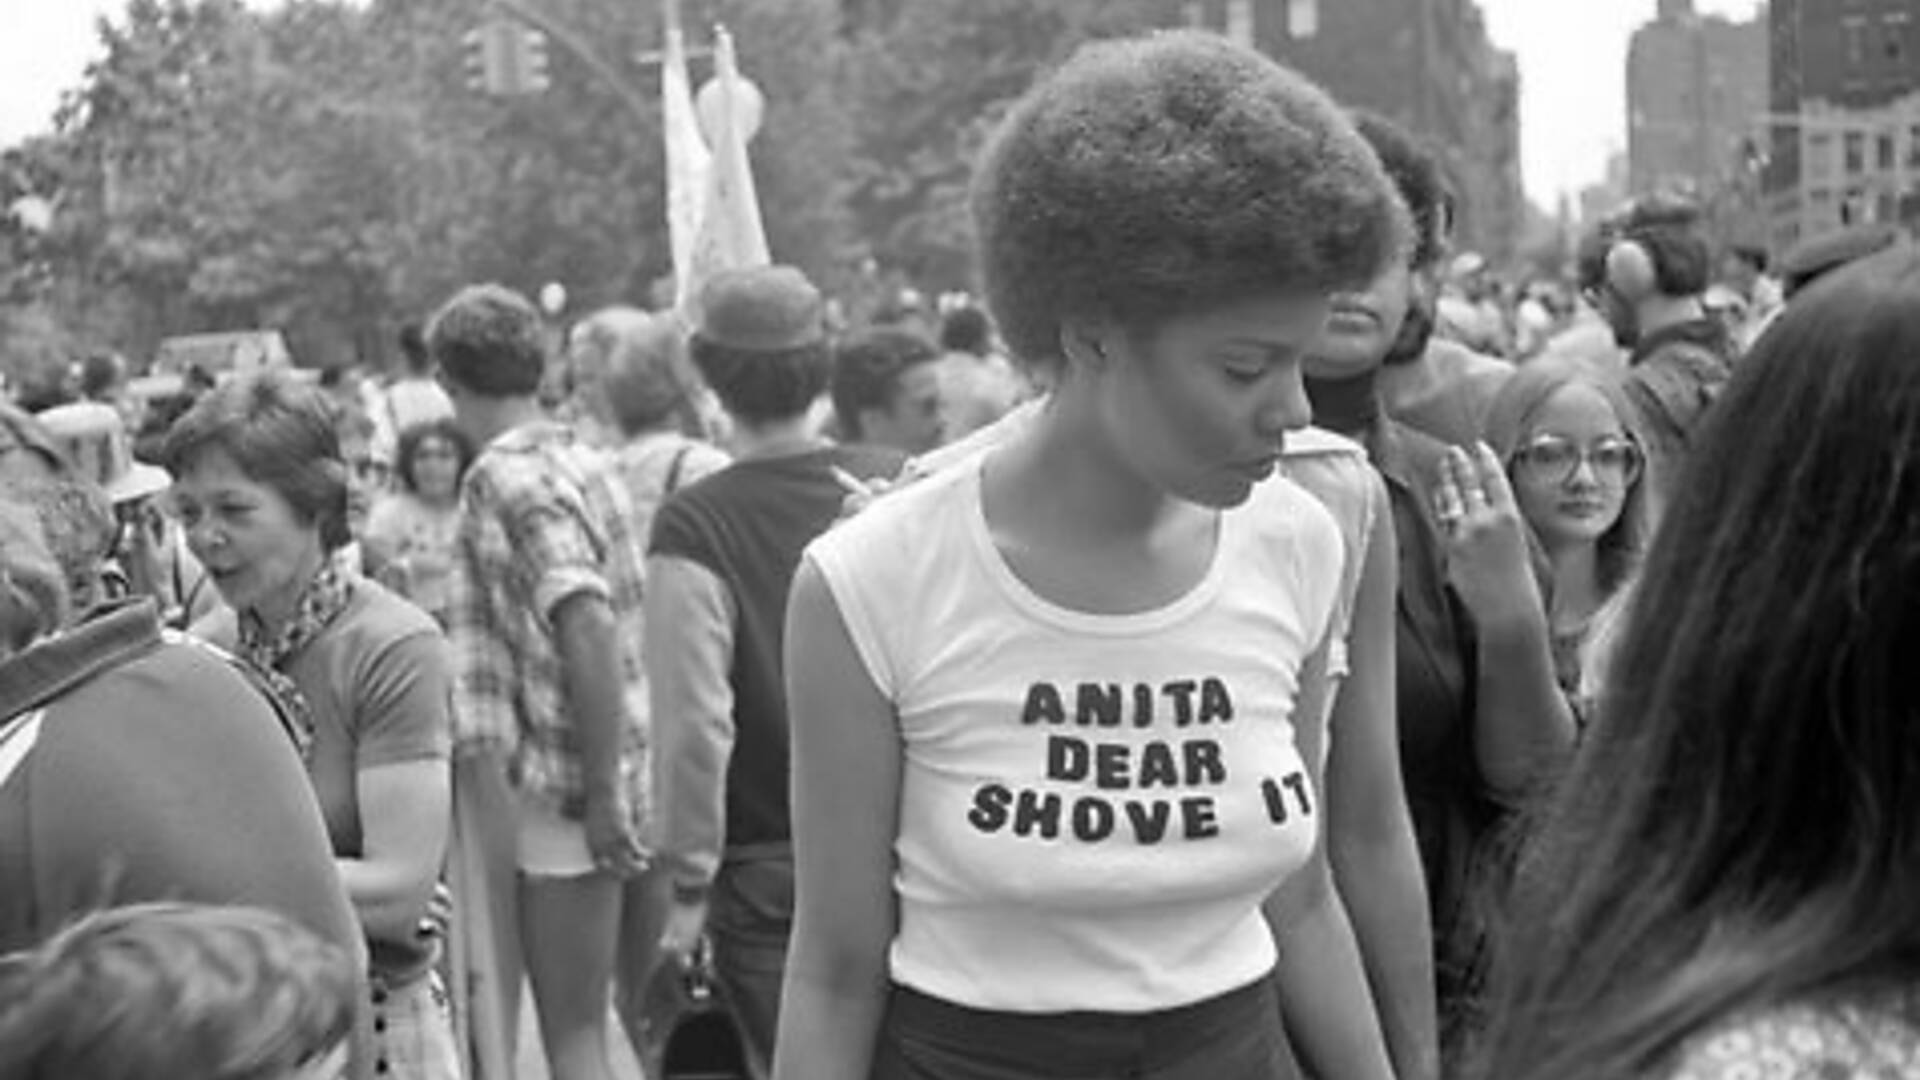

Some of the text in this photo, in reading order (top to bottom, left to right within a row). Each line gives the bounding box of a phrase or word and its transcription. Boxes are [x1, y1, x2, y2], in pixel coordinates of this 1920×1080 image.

[1021, 677, 1233, 728] ANITA
[1046, 735, 1226, 790] DEAR
[967, 771, 1312, 846] SHOVE IT
